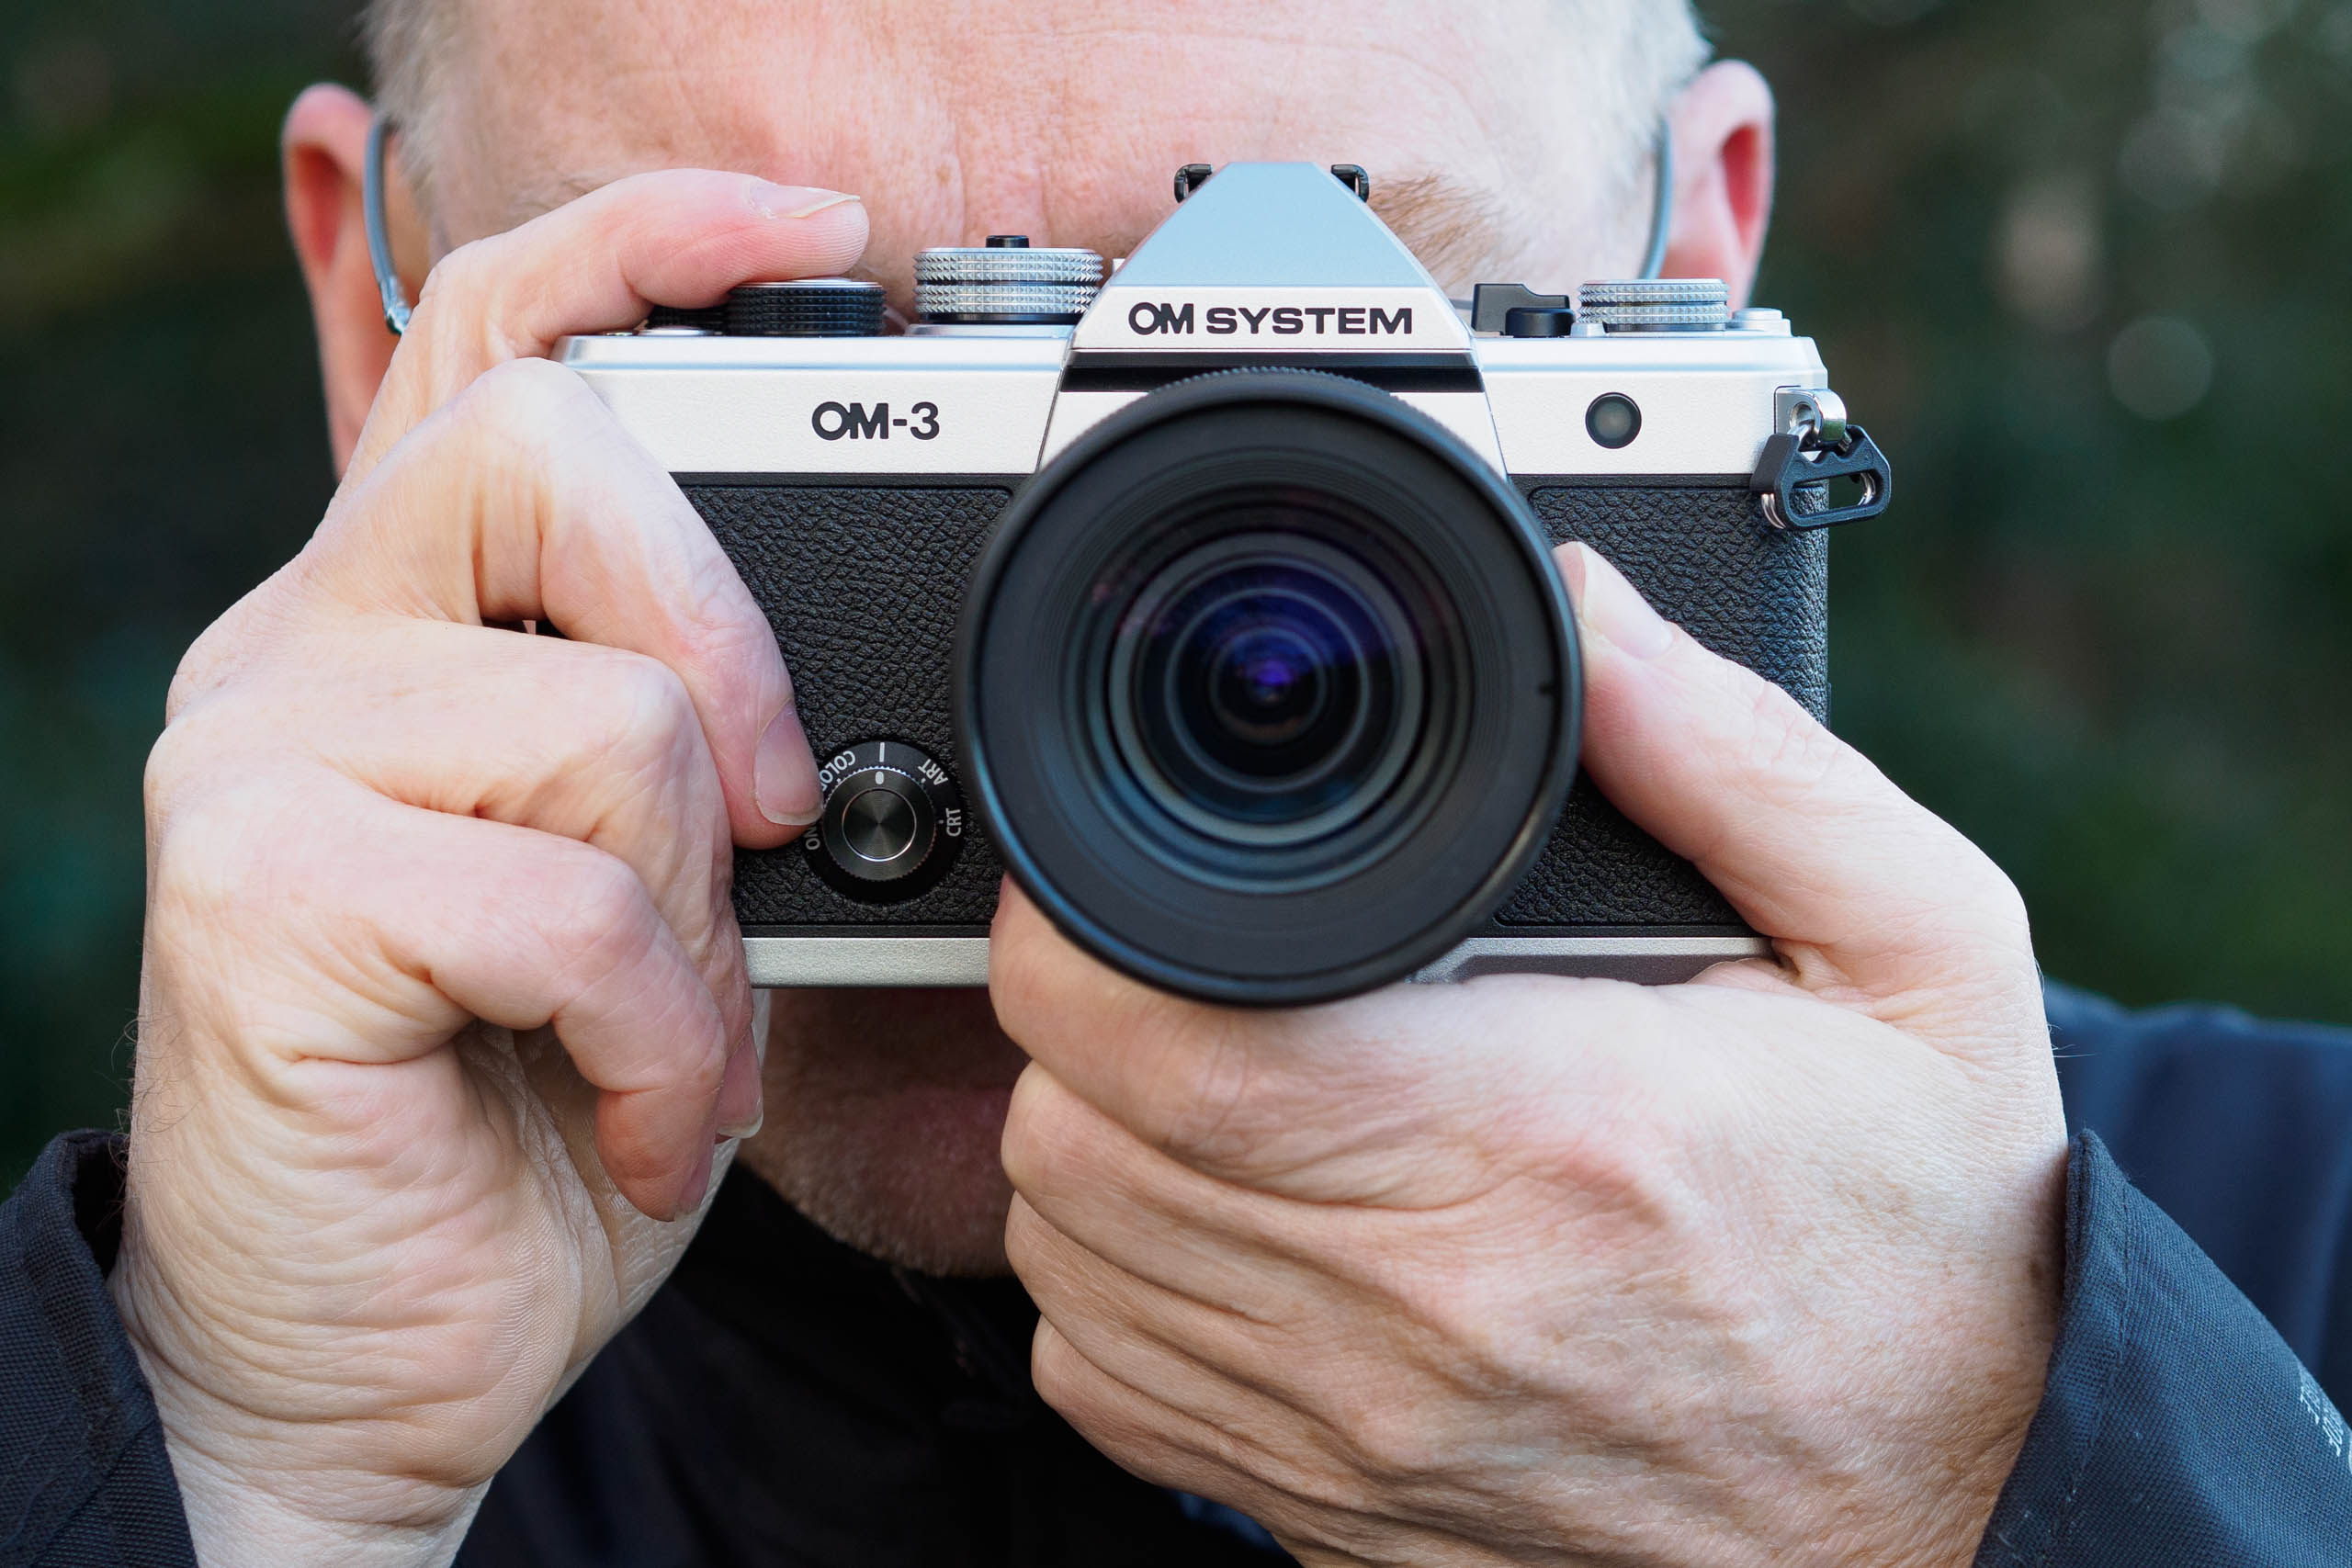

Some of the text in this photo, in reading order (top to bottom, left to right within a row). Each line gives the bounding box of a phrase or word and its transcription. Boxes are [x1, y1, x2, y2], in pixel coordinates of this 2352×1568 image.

[1128, 301, 1413, 335] OM SYSTEM
[811, 401, 940, 441] OM-3
[820, 750, 856, 792] COLO
[917, 758, 949, 786] ART
[945, 807, 962, 837] CRT
